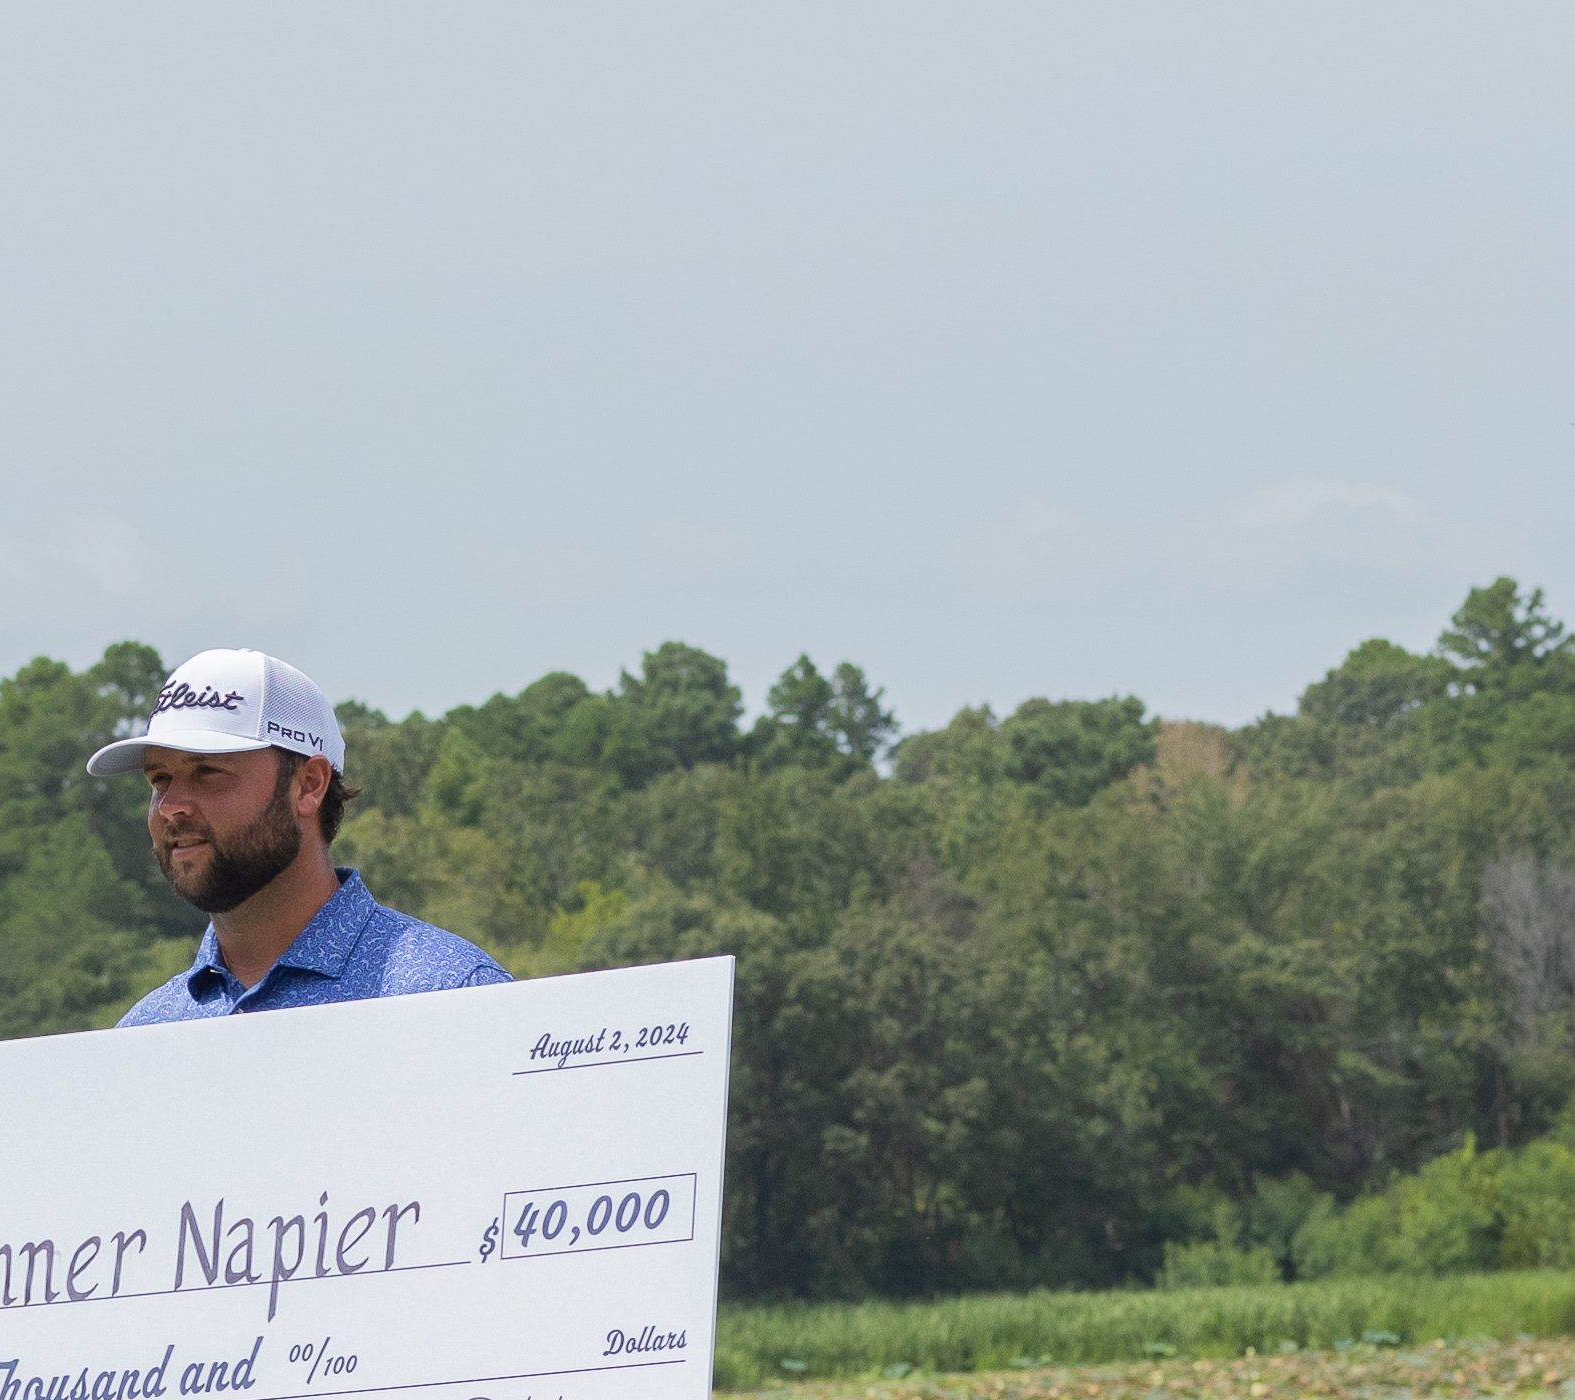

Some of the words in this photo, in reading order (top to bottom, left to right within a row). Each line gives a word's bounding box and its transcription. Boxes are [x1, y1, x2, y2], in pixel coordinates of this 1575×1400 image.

[267, 721, 305, 743] PRO
[530, 1028, 607, 1068] August
[609, 1030, 630, 1053] 2,
[635, 1022, 690, 1048] 2024
[479, 1217, 500, 1264] $
[513, 1189, 670, 1249] 40,000
[173, 1190, 421, 1323] Napier
[179, 1336, 264, 1395] and
[603, 1325, 688, 1357] Dollars
